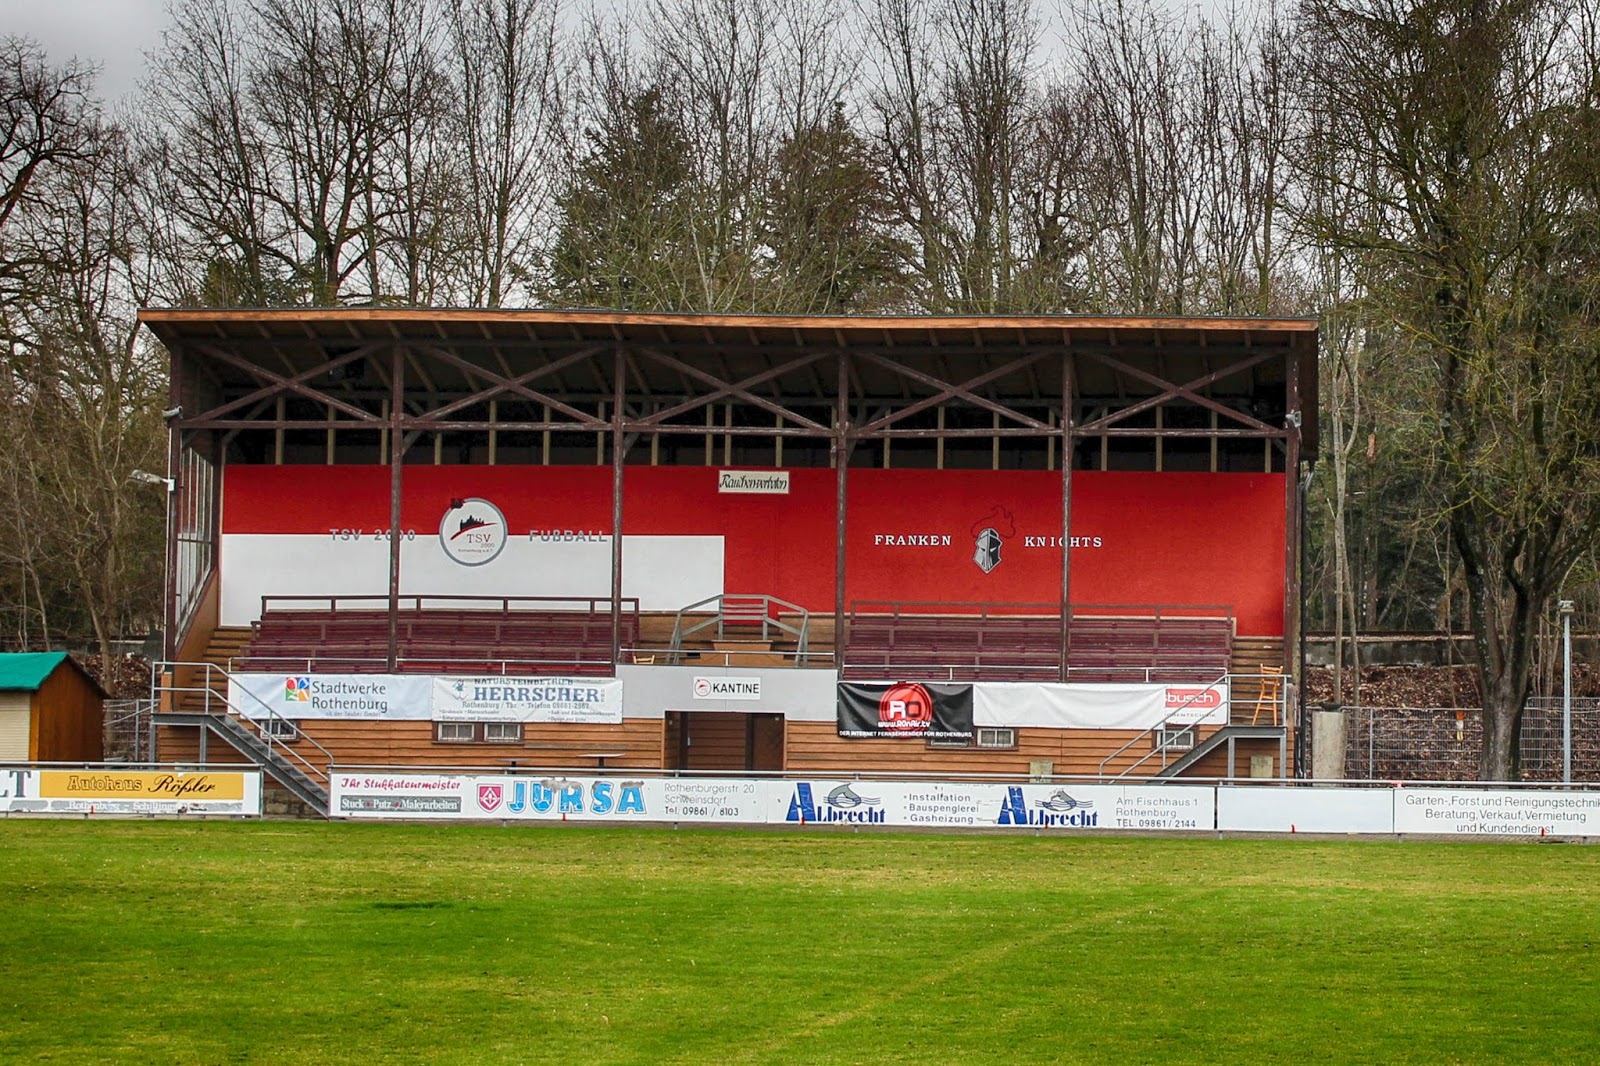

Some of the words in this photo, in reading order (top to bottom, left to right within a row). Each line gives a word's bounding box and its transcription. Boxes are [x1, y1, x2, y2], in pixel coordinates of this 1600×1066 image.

[329, 528, 362, 541] TSV
[466, 533, 491, 543] TSV
[874, 534, 952, 546] FRANKEN
[312, 680, 386, 694] Stadtwerke
[712, 683, 760, 694] KANTINE
[474, 687, 599, 702] HERRSCHER
[1167, 691, 1214, 703] busch
[312, 696, 388, 713] Rothenburg
[462, 701, 500, 710] Rothenburg
[67, 775, 142, 792] Autohaus
[148, 774, 216, 797] Rößler
[341, 778, 360, 788] Ihr
[664, 782, 739, 794] Rothenburgerstr
[743, 784, 755, 794] 20
[507, 780, 647, 814] JURSA
[664, 794, 727, 805] Schweinsdorf
[909, 793, 971, 802] Installation
[1116, 797, 1134, 806] Am
[1136, 797, 1191, 806] Fischhaus
[1193, 798, 1198, 806] 1
[1481, 796, 1502, 807] und
[341, 798, 364, 809] Stuck
[373, 799, 392, 809] Putz
[400, 799, 459, 811] Malerarbeiten
[909, 803, 979, 814] Bauspenglerei
[682, 806, 708, 815] 09861
[719, 807, 739, 816] 8103
[1116, 807, 1177, 819] Rothenburg
[910, 814, 974, 824] Gasheizung
[1524, 810, 1587, 824] Vermietung
[1175, 819, 1196, 828] 2144
[1456, 823, 1477, 833] und
[1480, 823, 1555, 834] Kundendienst
